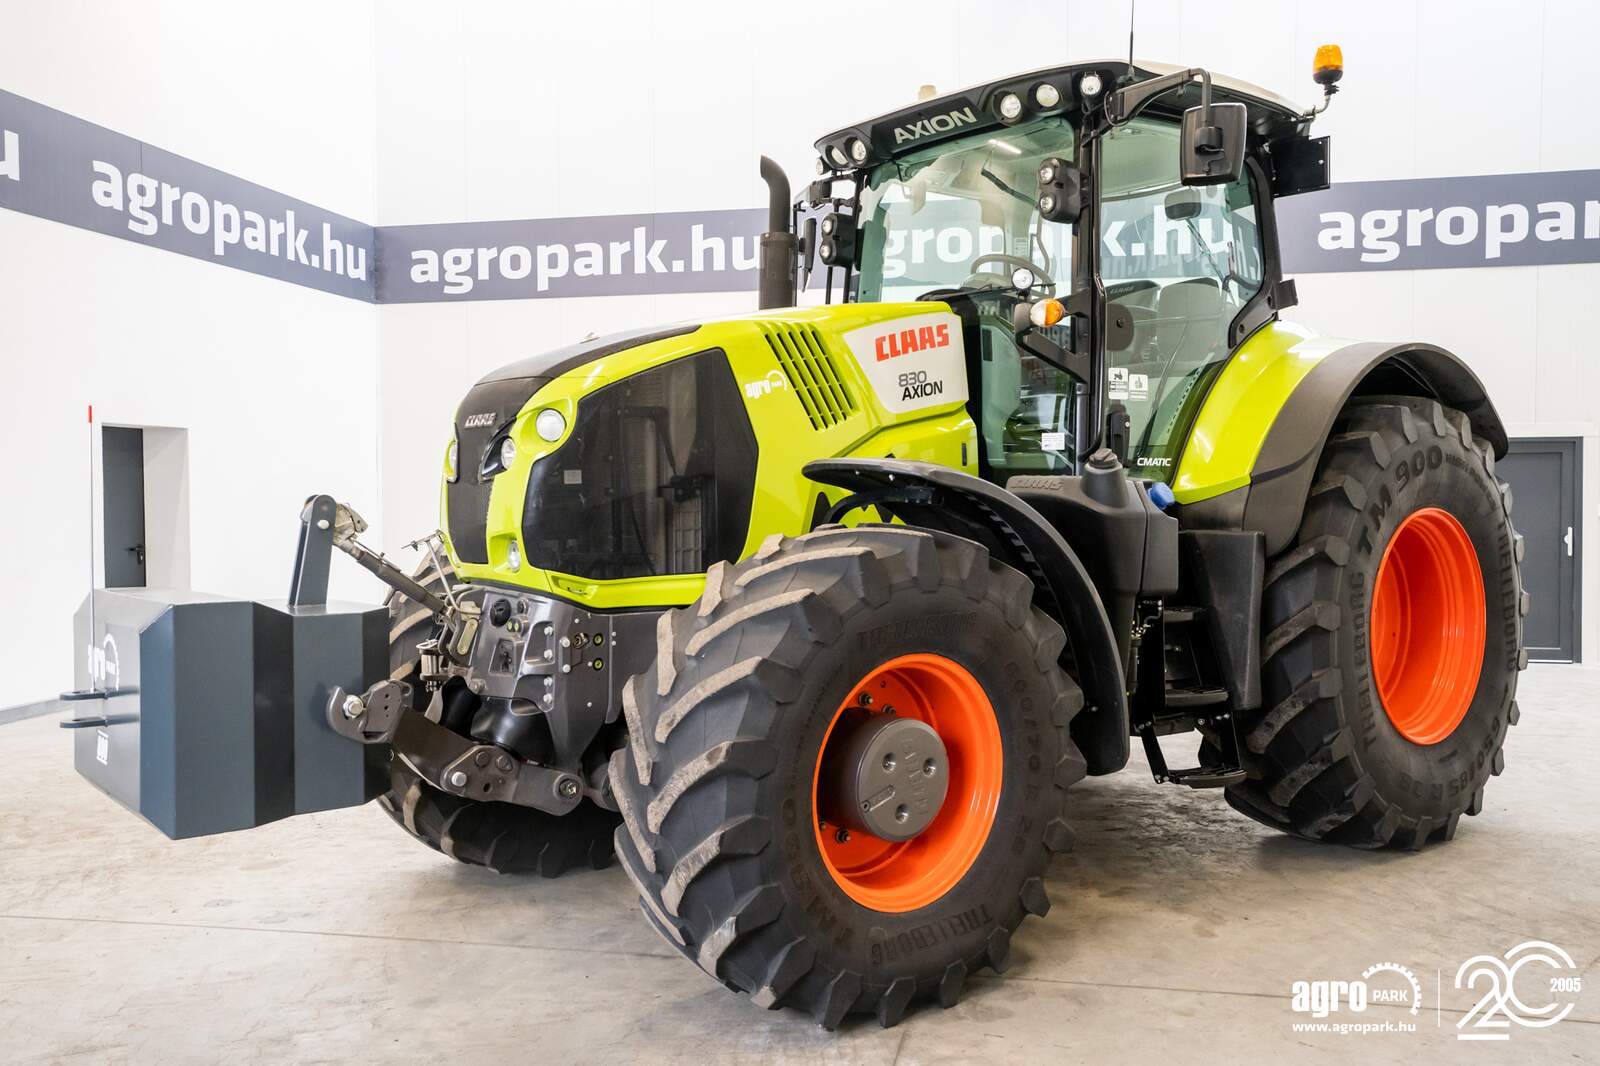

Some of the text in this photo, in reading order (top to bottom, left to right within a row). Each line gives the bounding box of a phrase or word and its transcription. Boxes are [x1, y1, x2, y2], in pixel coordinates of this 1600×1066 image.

[893, 106, 977, 144] AXION
[92, 159, 367, 281] agropark.hu
[410, 223, 762, 294] agropark.hu
[874, 323, 950, 363] CLAAS
[898, 370, 927, 388] 830
[901, 380, 944, 401] AXION
[1136, 456, 1173, 467] CMATIC
[1396, 444, 1443, 492] 900
